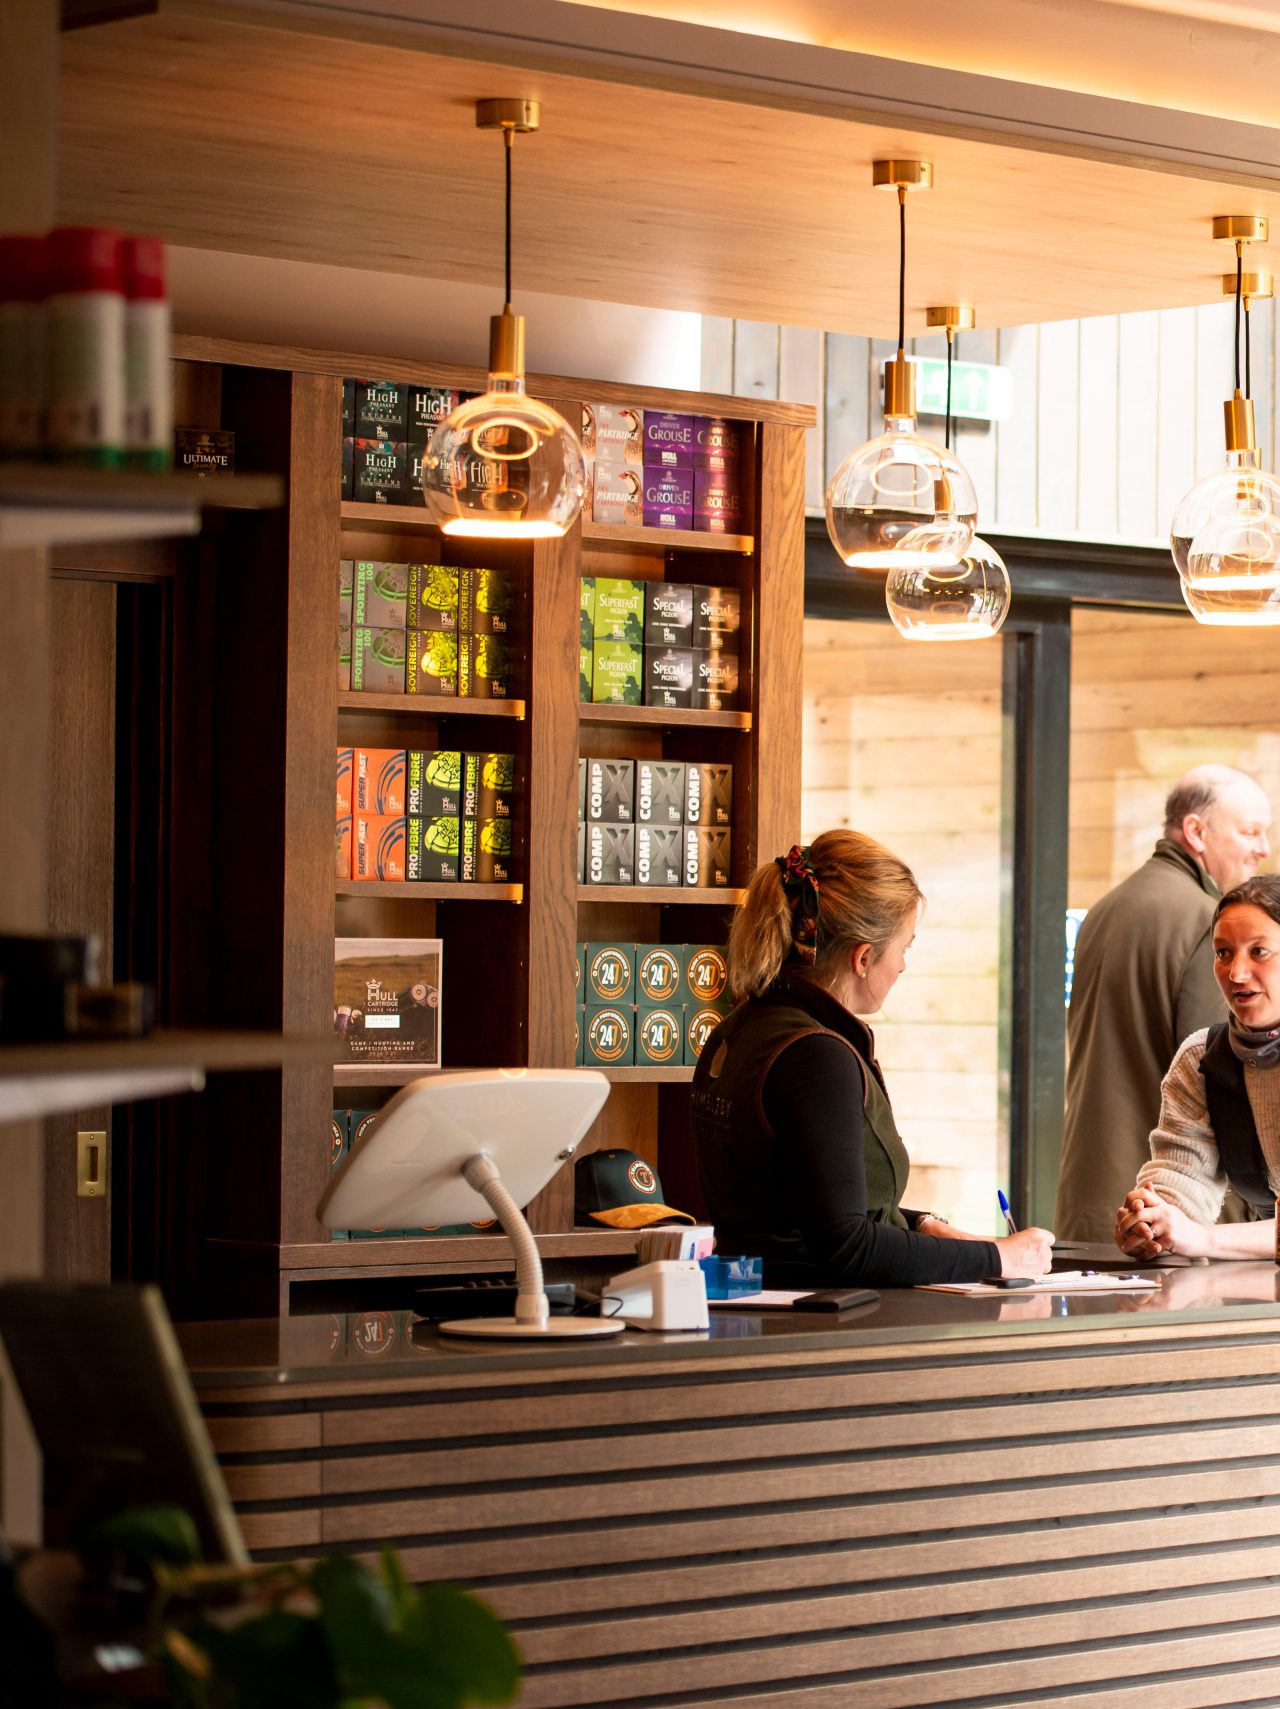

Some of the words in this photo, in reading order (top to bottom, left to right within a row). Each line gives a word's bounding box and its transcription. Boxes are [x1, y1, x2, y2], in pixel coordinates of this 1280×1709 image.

[367, 389, 398, 404] HIGH
[415, 393, 452, 415] HIGH
[597, 429, 639, 441] PARTRIDGE
[648, 425, 691, 443] GROUSE
[183, 453, 229, 466] ULTIMATE
[365, 454, 397, 469] HIGH
[596, 492, 639, 503] PARTRIDGE
[646, 488, 691, 505] GROUSE
[366, 563, 374, 580] 100
[356, 562, 365, 625] SPORTING
[408, 566, 417, 626] SOVEREIGN
[461, 570, 469, 630] SOVEREIGN
[599, 594, 640, 609] SUPERFAST
[653, 598, 686, 612] SPECIAL
[700, 603, 733, 617] SPECIAL
[354, 628, 363, 690] SPORTING
[408, 632, 417, 693] SOVEREIGN
[460, 635, 469, 696] SOVEREIGN
[598, 657, 638, 671] SUPERFAST
[653, 661, 686, 675] SPECIAL
[699, 664, 731, 678] SPECIAL
[409, 752, 420, 814] PROFIBRE
[465, 755, 477, 816] PROFIBRE
[591, 763, 603, 819] COMP
[604, 764, 630, 804] X
[639, 765, 652, 821] COMP
[654, 767, 681, 805] X
[688, 767, 700, 822] COMP
[703, 769, 729, 807] X
[408, 818, 420, 879] PROFIBRE
[463, 820, 474, 881] PROFIBRE
[591, 826, 603, 882] COMP
[604, 828, 630, 867] X
[638, 828, 651, 883] COMP
[651, 829, 679, 868] X
[686, 830, 699, 884] COMP
[702, 831, 727, 868] X
[368, 988, 399, 1001] HULL
